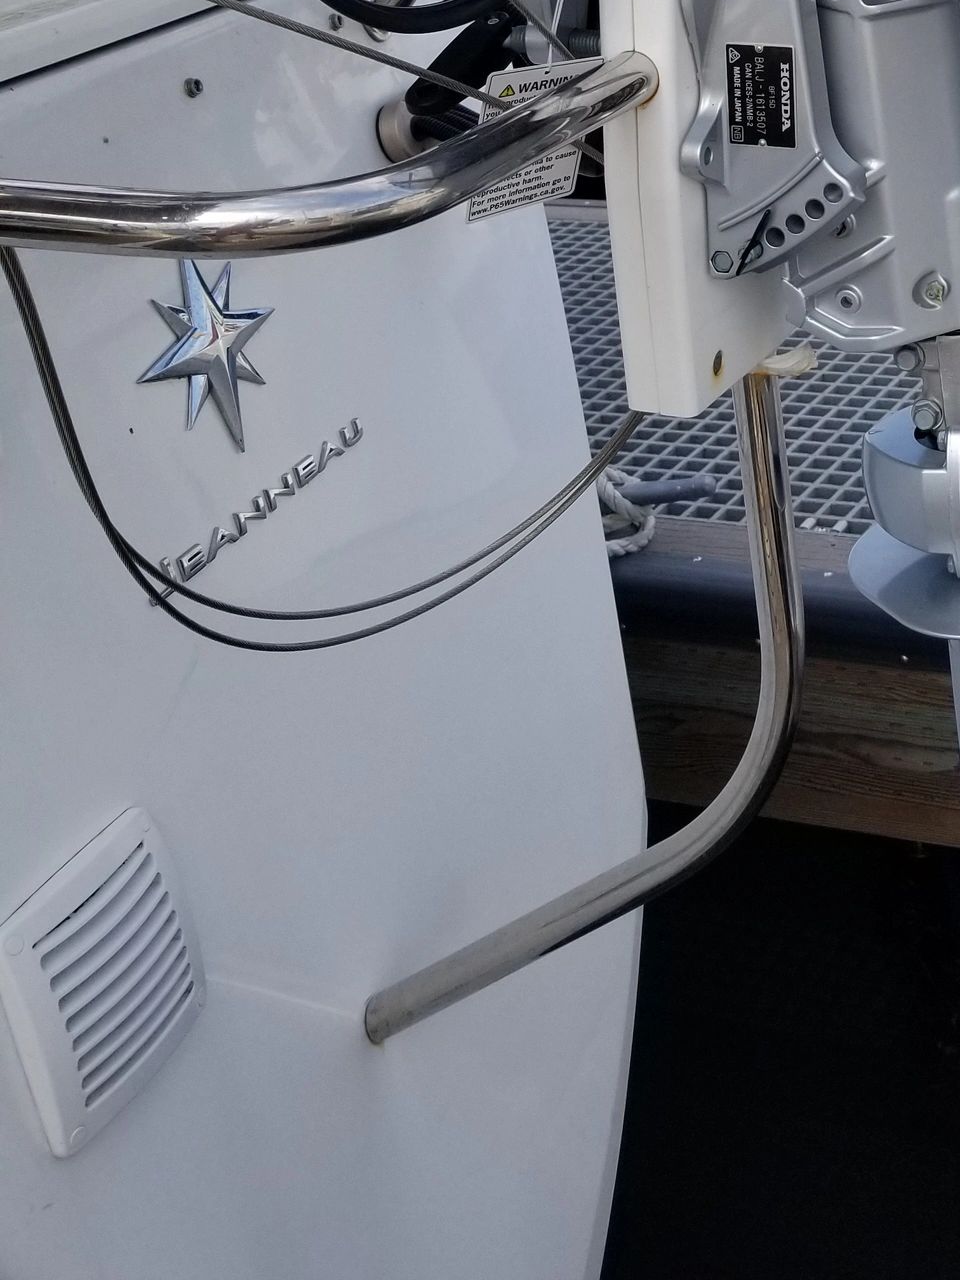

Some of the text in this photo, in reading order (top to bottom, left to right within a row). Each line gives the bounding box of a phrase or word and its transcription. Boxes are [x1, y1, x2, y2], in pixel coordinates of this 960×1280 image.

[733, 66, 741, 88] MADE
[744, 63, 753, 78] CAN
[754, 57, 764, 82] BALJ
[519, 75, 573, 93] WARNI
[734, 89, 741, 97] IN
[507, 95, 536, 106] rodu
[768, 85, 776, 109] BF15D
[780, 62, 791, 132] HONDA
[734, 97, 742, 122] JAPAN
[756, 94, 767, 135] 1613507
[555, 150, 577, 160] cause
[503, 173, 522, 182] ects
[534, 163, 554, 174] other
[522, 175, 544, 185] harm.
[471, 185, 566, 217] www.P65Warnings.ca.gov.
[472, 199, 485, 208] For
[487, 194, 507, 202] more
[508, 181, 550, 197] information
[552, 178, 561, 187] go
